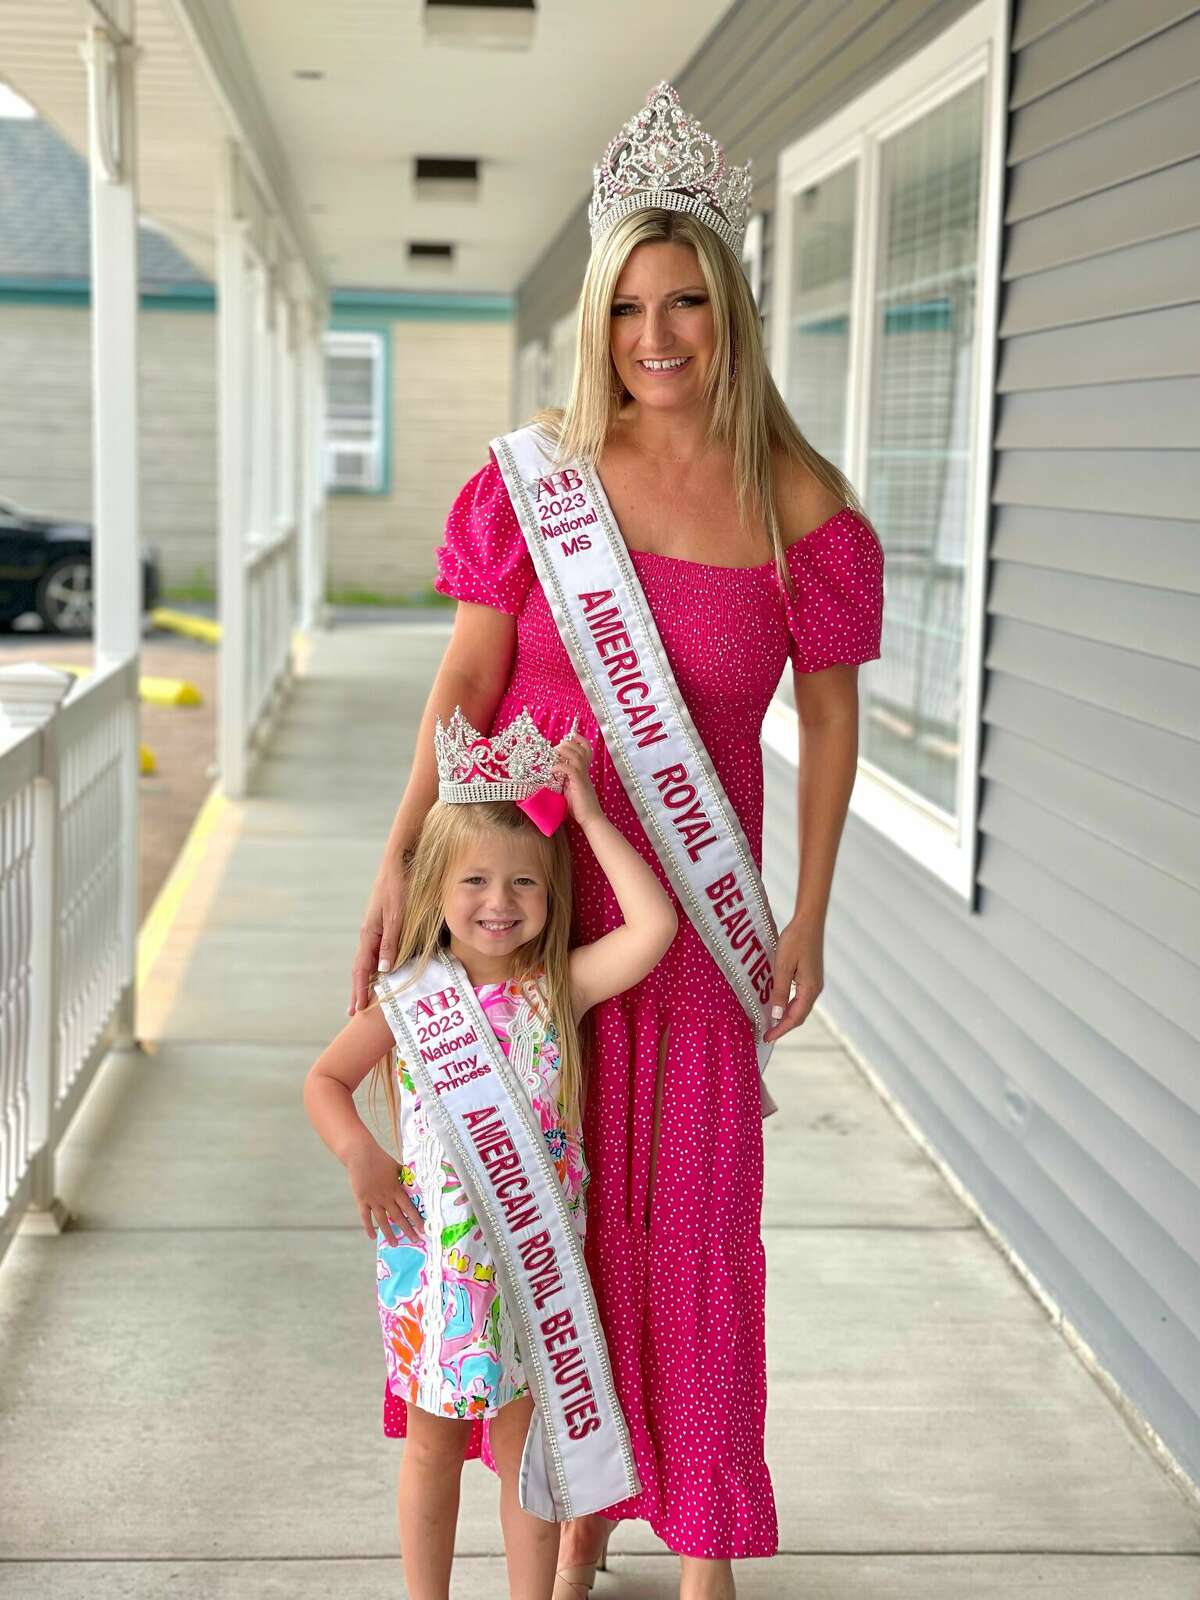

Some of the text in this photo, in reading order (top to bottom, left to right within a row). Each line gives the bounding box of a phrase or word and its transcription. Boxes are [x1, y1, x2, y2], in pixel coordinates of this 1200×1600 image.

[538, 493, 586, 521] 2023
[540, 508, 598, 541] National
[561, 534, 592, 557] MS
[578, 588, 774, 1006] AMERICAN ROYAL BEAUTIES
[417, 1010, 464, 1044] 2023
[419, 1025, 478, 1065] National
[433, 1063, 492, 1096] Princess
[439, 1055, 478, 1080] Tiny
[462, 1105, 602, 1441] AMERICAN ROYAL BEAUTIES
